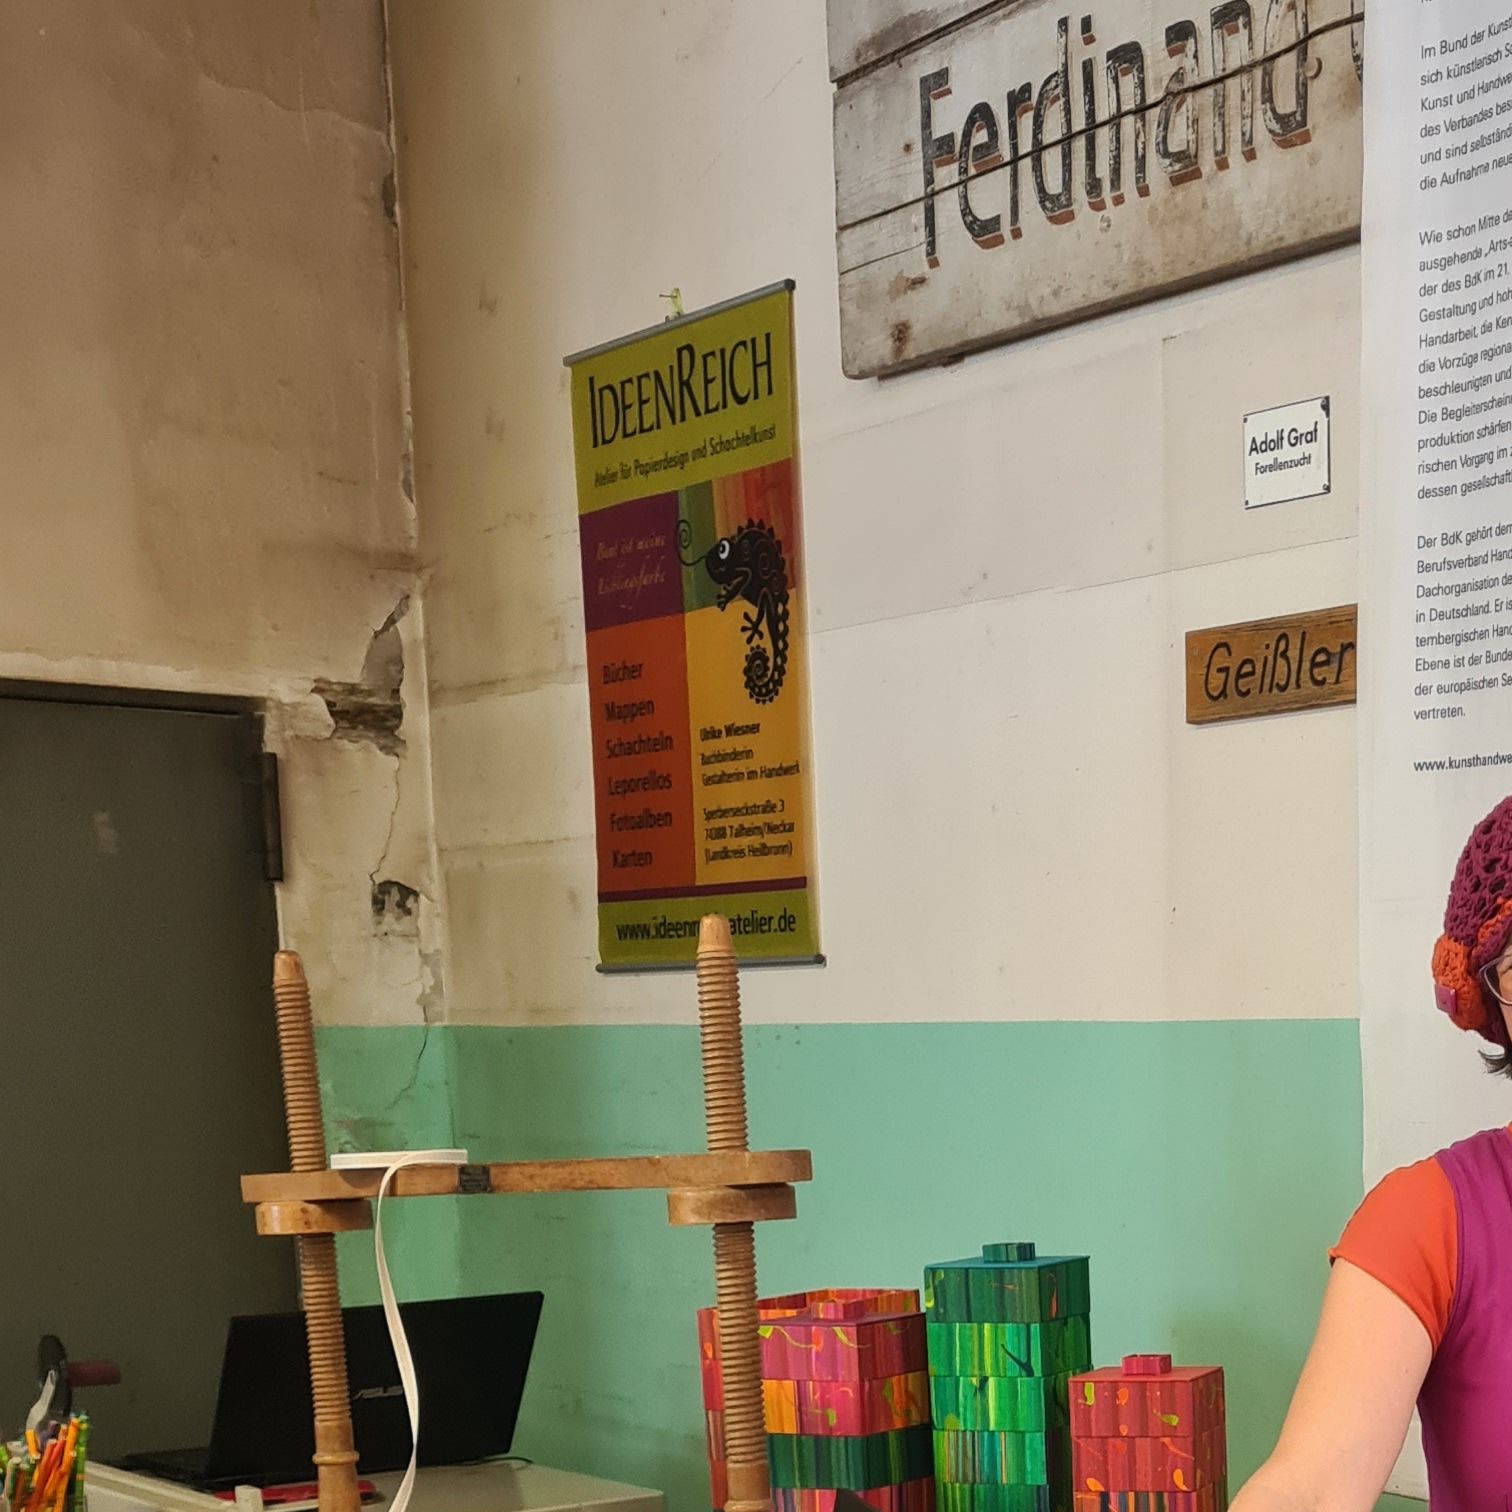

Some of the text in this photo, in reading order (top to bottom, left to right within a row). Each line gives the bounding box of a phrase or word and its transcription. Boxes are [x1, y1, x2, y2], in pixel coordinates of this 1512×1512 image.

[1421, 29, 1485, 59] Im Bund der
[1421, 69, 1442, 85] sich
[1421, 95, 1453, 111] Kunst
[1457, 87, 1474, 104] und
[1421, 124, 1440, 138] des
[1444, 105, 1493, 133] Verbandes
[919, 0, 1312, 268] Ferdinand
[1421, 148, 1441, 164] und
[1446, 141, 1467, 159] sind
[1420, 175, 1436, 190] die
[1440, 162, 1489, 186] Aufnahme
[1419, 230, 1442, 245] Wie
[1447, 224, 1476, 241] schon
[1419, 246, 1482, 272] ausgehende
[1419, 284, 1438, 297] der
[1442, 278, 1461, 294] des
[1419, 301, 1477, 323] Gestaltung
[1418, 359, 1435, 374] die
[1438, 351, 1478, 372] Vorzüge
[1418, 373, 1492, 399] beschleunigten
[1495, 367, 1512, 384] und
[1418, 409, 1437, 425] Die
[1248, 421, 1318, 456] Adolf Graf
[1418, 430, 1474, 452] produktion
[1477, 420, 1512, 440] schärfen
[634, 452, 689, 477] Papierdesign
[692, 439, 706, 461] und
[710, 424, 776, 456] Schachtelkunst
[1418, 459, 1457, 475] rischen
[1460, 450, 1494, 469] Vorgang
[1255, 454, 1311, 476] Forellenzucht
[1418, 484, 1457, 500] dessen
[1418, 534, 1437, 549] Der
[1441, 531, 1463, 546] BdK
[1417, 553, 1488, 574] Berufsverband
[1417, 573, 1499, 598] Dachorganisation
[1416, 626, 1489, 648] tembergischen
[603, 661, 643, 685] Bücher
[1204, 631, 1355, 702] Geißler
[1416, 657, 1450, 672] Ebene
[1415, 683, 1433, 696] der
[1437, 675, 1498, 695] europäischen
[605, 698, 654, 722] Mappen
[1414, 705, 1465, 720] vertreten.
[606, 732, 672, 759] Schachteln
[609, 772, 672, 797] Leporellos
[610, 809, 672, 833] Fotoalben
[612, 850, 652, 869] Karten
